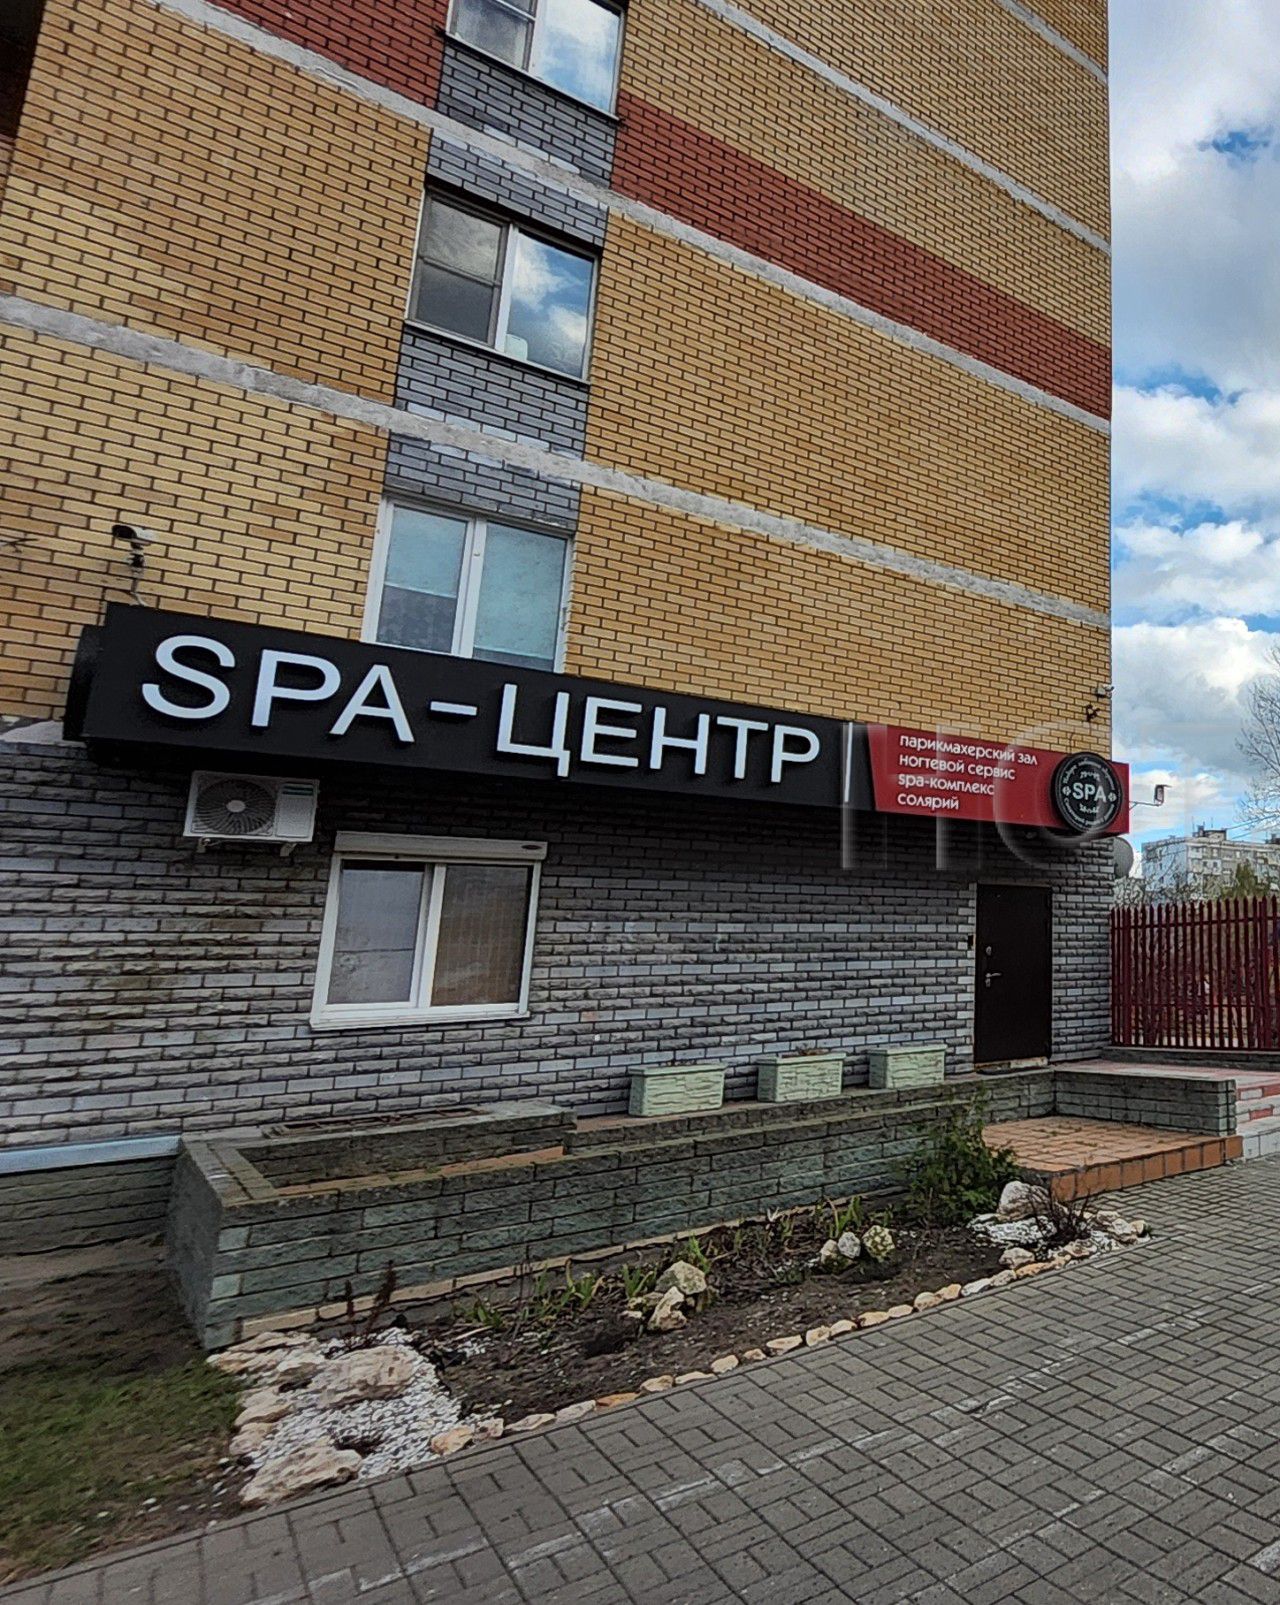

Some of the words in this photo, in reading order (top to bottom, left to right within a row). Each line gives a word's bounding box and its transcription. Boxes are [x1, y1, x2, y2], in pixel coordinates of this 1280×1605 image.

[900, 735, 1015, 762] парикмахерский
[1017, 752, 1038, 765] зал
[899, 754, 965, 774] ногтевой
[967, 763, 1016, 780] сервис
[898, 773, 995, 796] spa-комплекс
[1072, 782, 1107, 803] SPA
[897, 793, 960, 811] солярий
